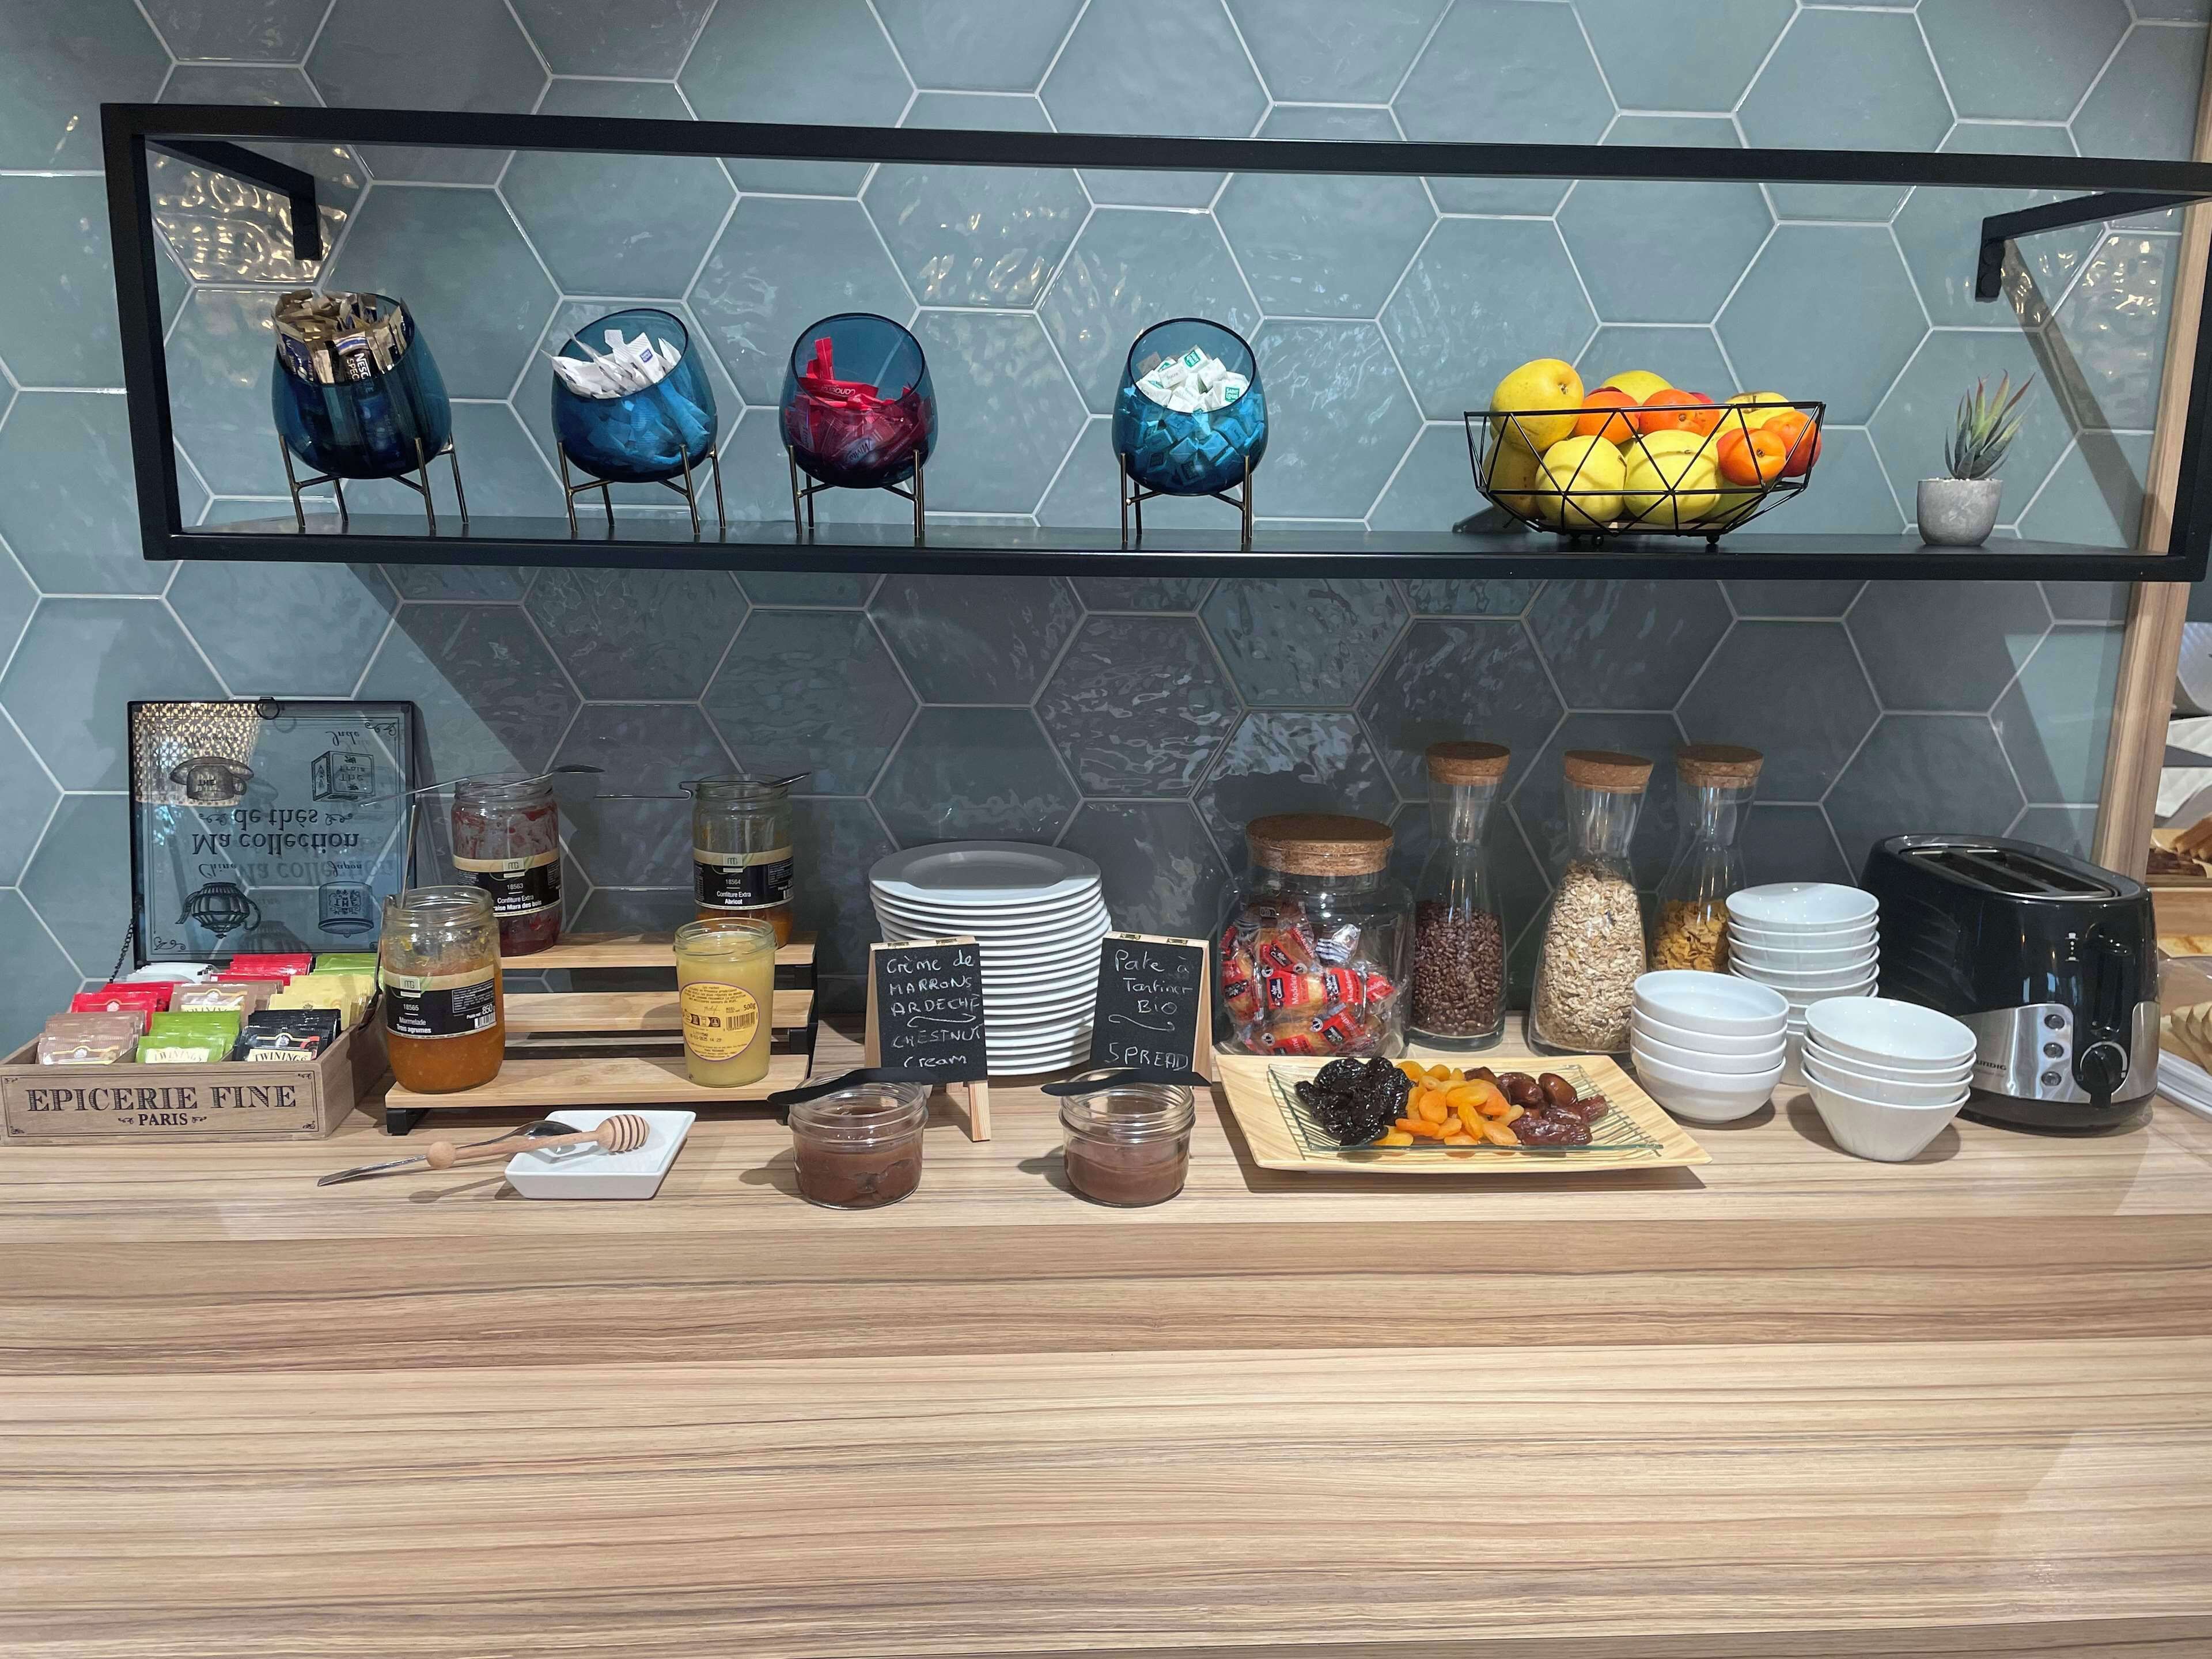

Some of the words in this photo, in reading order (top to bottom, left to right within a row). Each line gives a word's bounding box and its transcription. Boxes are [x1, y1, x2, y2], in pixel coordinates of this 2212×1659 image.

[347, 358, 360, 381] SPEC
[354, 353, 372, 380] NESC
[497, 895, 521, 904] Confiture
[887, 955, 942, 974] Crème
[953, 949, 974, 967] de
[889, 975, 972, 996] MARRONS
[1123, 977, 1194, 994] Tartiner
[482, 1003, 493, 1015] 850
[743, 1003, 757, 1011] 500g
[396, 1023, 407, 1032] Trois
[399, 1016, 426, 1026] Marmelade
[892, 1023, 984, 1049] CHESTNUT
[1104, 1042, 1189, 1071] SPREAD
[1976, 1059, 2006, 1070] UNDIG
[26, 1086, 198, 1112] EPICERIE
[210, 1085, 297, 1109] FINE
[139, 1113, 188, 1126] PARIS
